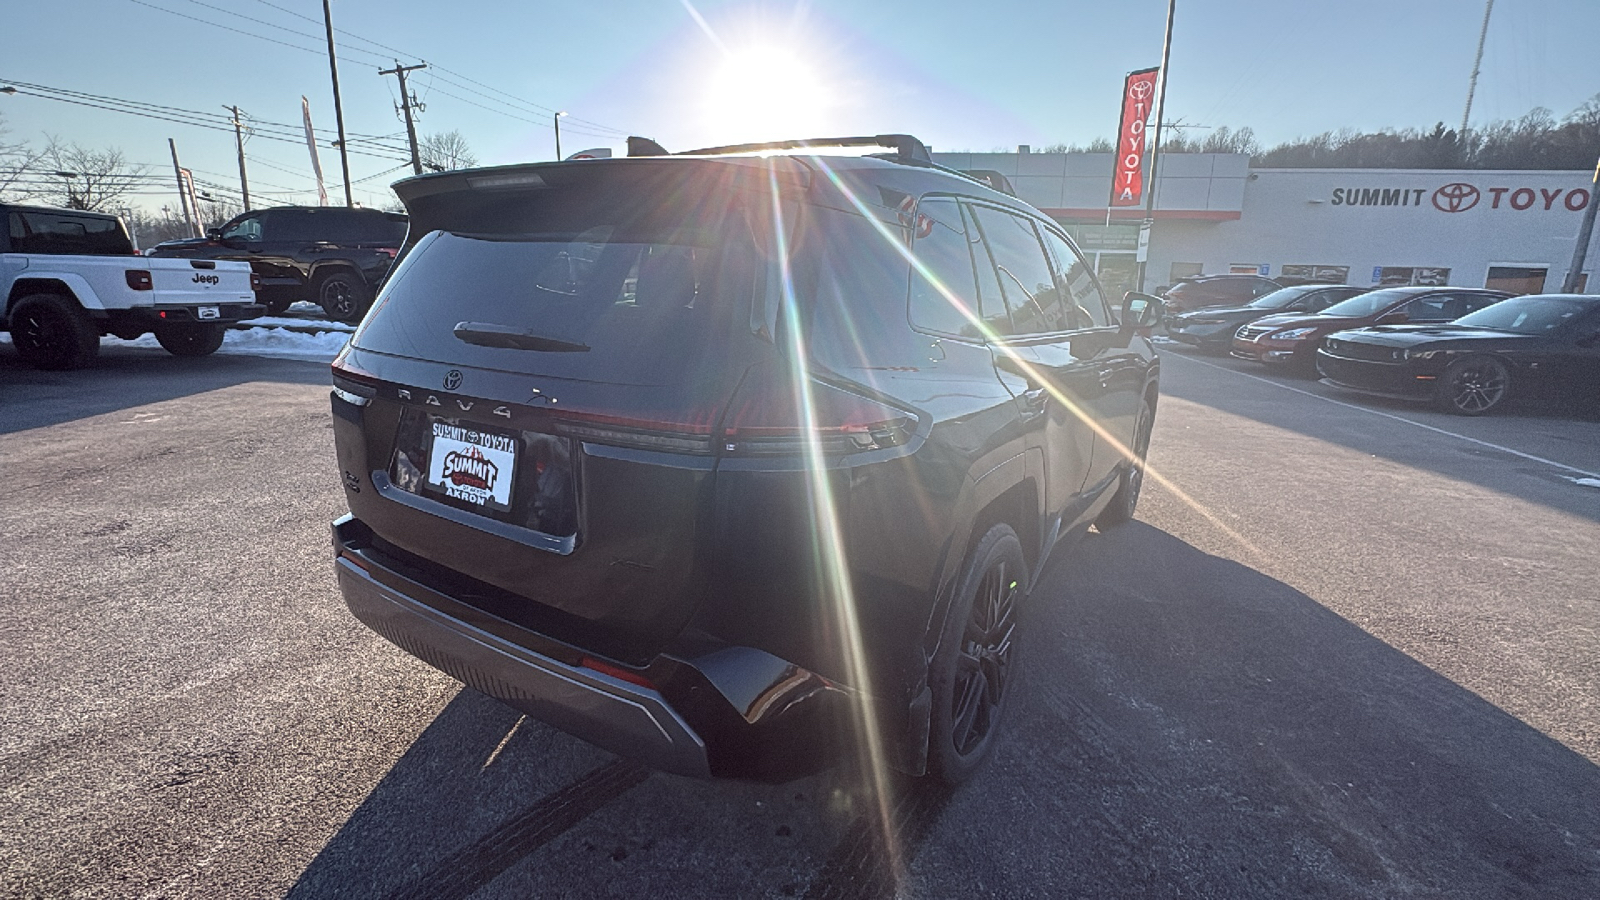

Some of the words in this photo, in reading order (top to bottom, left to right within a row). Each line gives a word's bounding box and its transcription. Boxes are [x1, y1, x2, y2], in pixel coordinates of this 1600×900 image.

[1120, 103, 1144, 200] TOYOTA
[1331, 187, 1426, 206] SUMMIT
[191, 273, 219, 285] Jeep
[398, 389, 511, 418] RAV4
[432, 422, 467, 442] SUMMIT
[480, 434, 514, 454] TOYOTA
[444, 453, 497, 487] SUMMIT
[445, 487, 485, 505] AKRON
